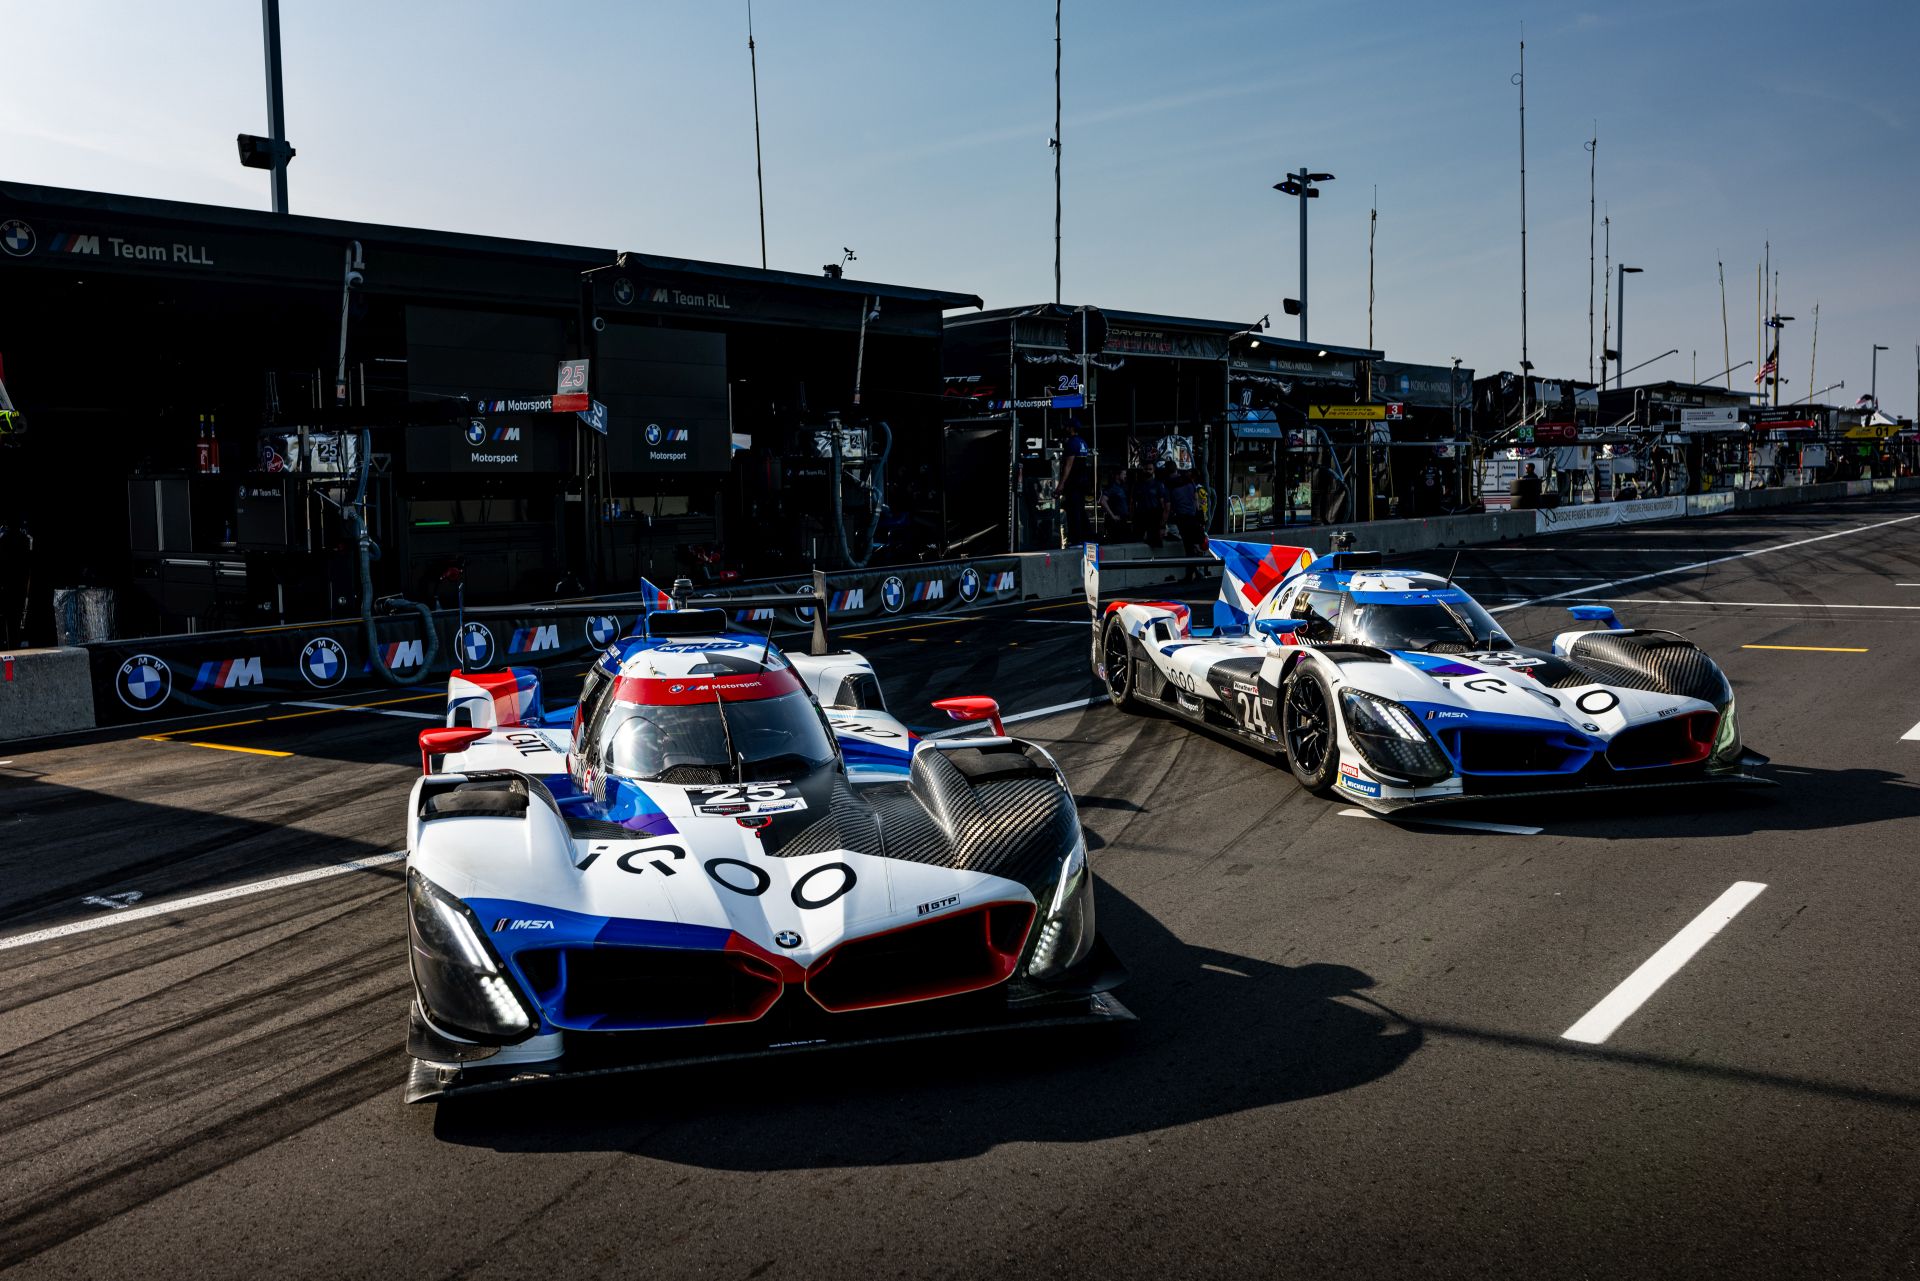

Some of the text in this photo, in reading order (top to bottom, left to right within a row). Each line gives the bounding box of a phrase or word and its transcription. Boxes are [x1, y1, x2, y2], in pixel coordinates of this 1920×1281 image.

[108, 237, 167, 261] Team
[173, 243, 214, 266] RLL
[672, 290, 705, 307] Team
[707, 293, 731, 309] RLL
[561, 366, 585, 387] 25
[1058, 375, 1079, 391] 24
[508, 399, 552, 412] Motorsport
[1013, 399, 1052, 409] Motorsport
[1391, 405, 1399, 415] 3
[1727, 411, 1733, 420] 6
[1794, 410, 1801, 419] 7
[1519, 428, 1532, 438] 93
[1582, 425, 1664, 435] PORSCHE
[1875, 427, 1889, 436] 01
[320, 444, 338, 457] 25
[650, 451, 687, 461] Motorsport
[471, 453, 519, 463] Motorsport
[712, 681, 762, 690] Motorsport
[1237, 691, 1267, 735] 24
[506, 733, 552, 757] CATL
[1347, 780, 1376, 793] MICHELIN
[701, 783, 786, 804] 25
[931, 896, 957, 910] GTP
[510, 919, 555, 930] IMSA
